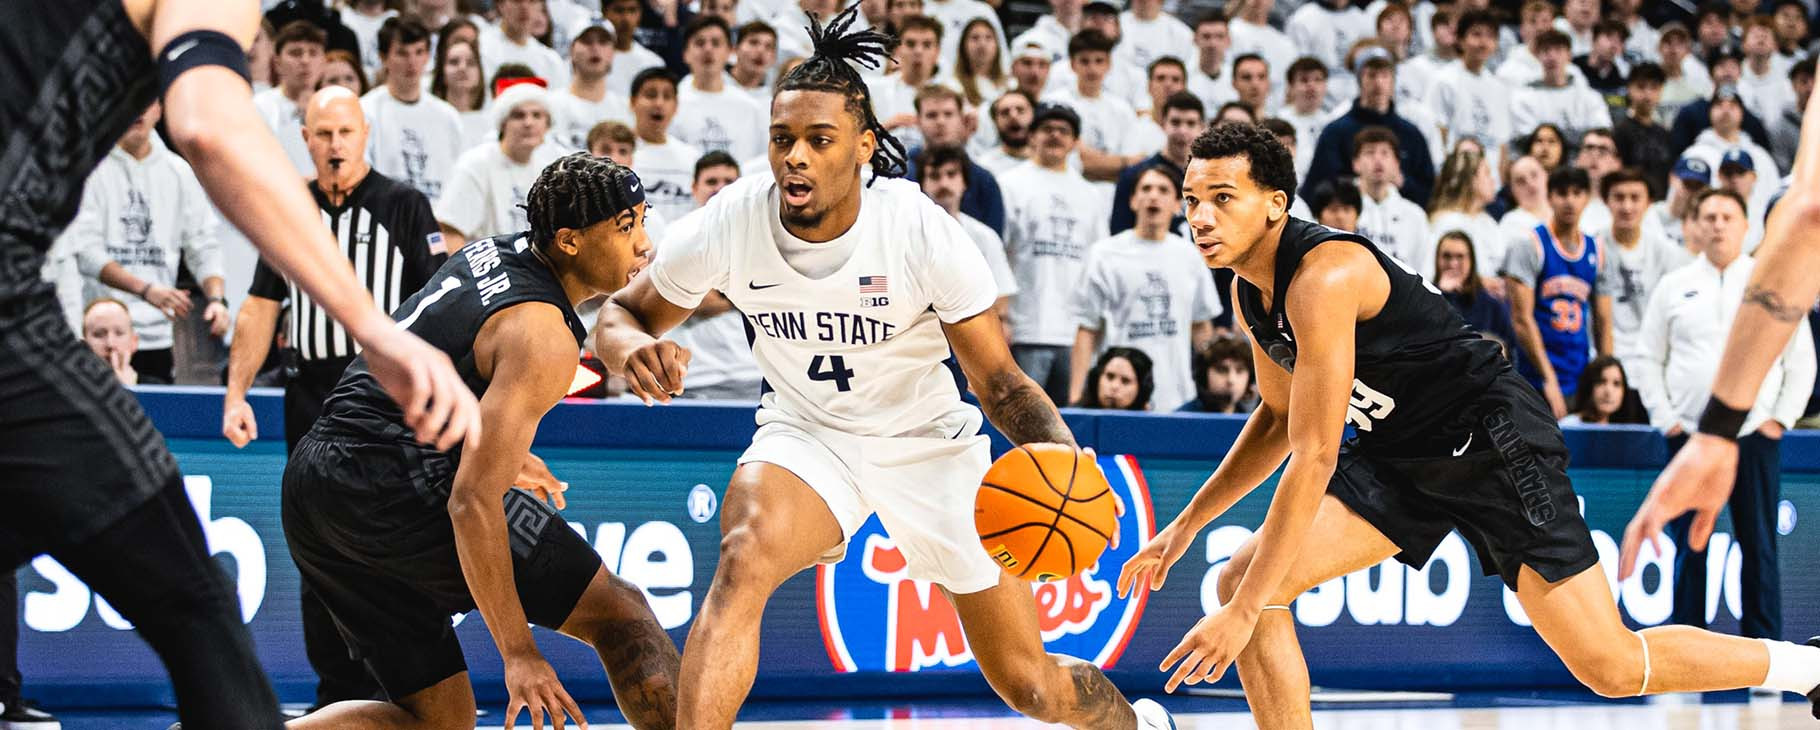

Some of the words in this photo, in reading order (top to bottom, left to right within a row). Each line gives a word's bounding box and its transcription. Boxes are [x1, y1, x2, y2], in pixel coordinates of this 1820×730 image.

[462, 238, 501, 278] FEARS
[476, 272, 511, 307] JR.
[816, 311, 896, 345] STATE
[806, 354, 855, 392] 4
[1483, 405, 1558, 528] SPARTANS
[24, 474, 267, 633] sb
